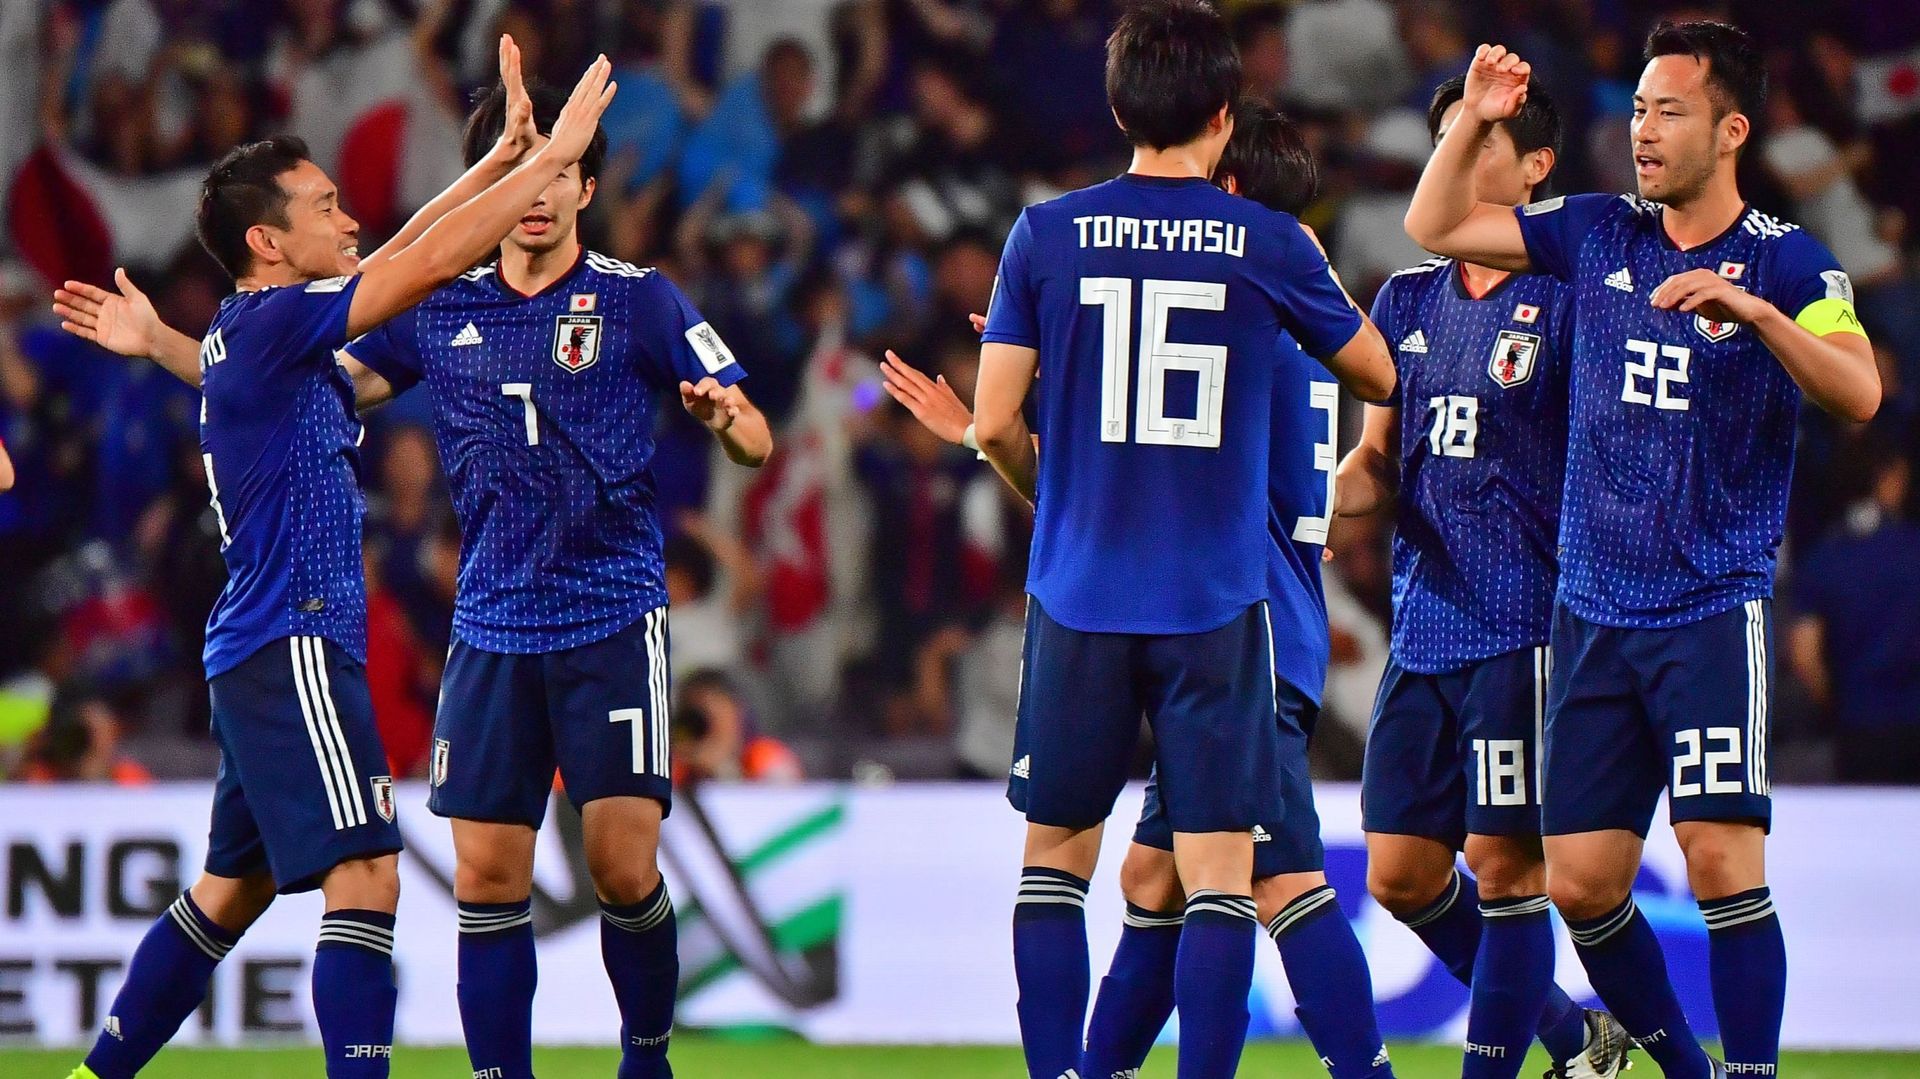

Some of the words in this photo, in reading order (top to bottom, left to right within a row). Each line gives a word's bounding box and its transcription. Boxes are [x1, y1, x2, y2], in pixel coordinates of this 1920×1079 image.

[1073, 215, 1246, 258] TOMIYASU
[1080, 277, 1228, 448] 16
[1621, 338, 1691, 411] 22
[501, 382, 539, 446] 7
[1428, 394, 1479, 458] 18
[608, 707, 645, 774] 7
[1472, 739, 1526, 806] 18
[1672, 726, 1743, 798] 22
